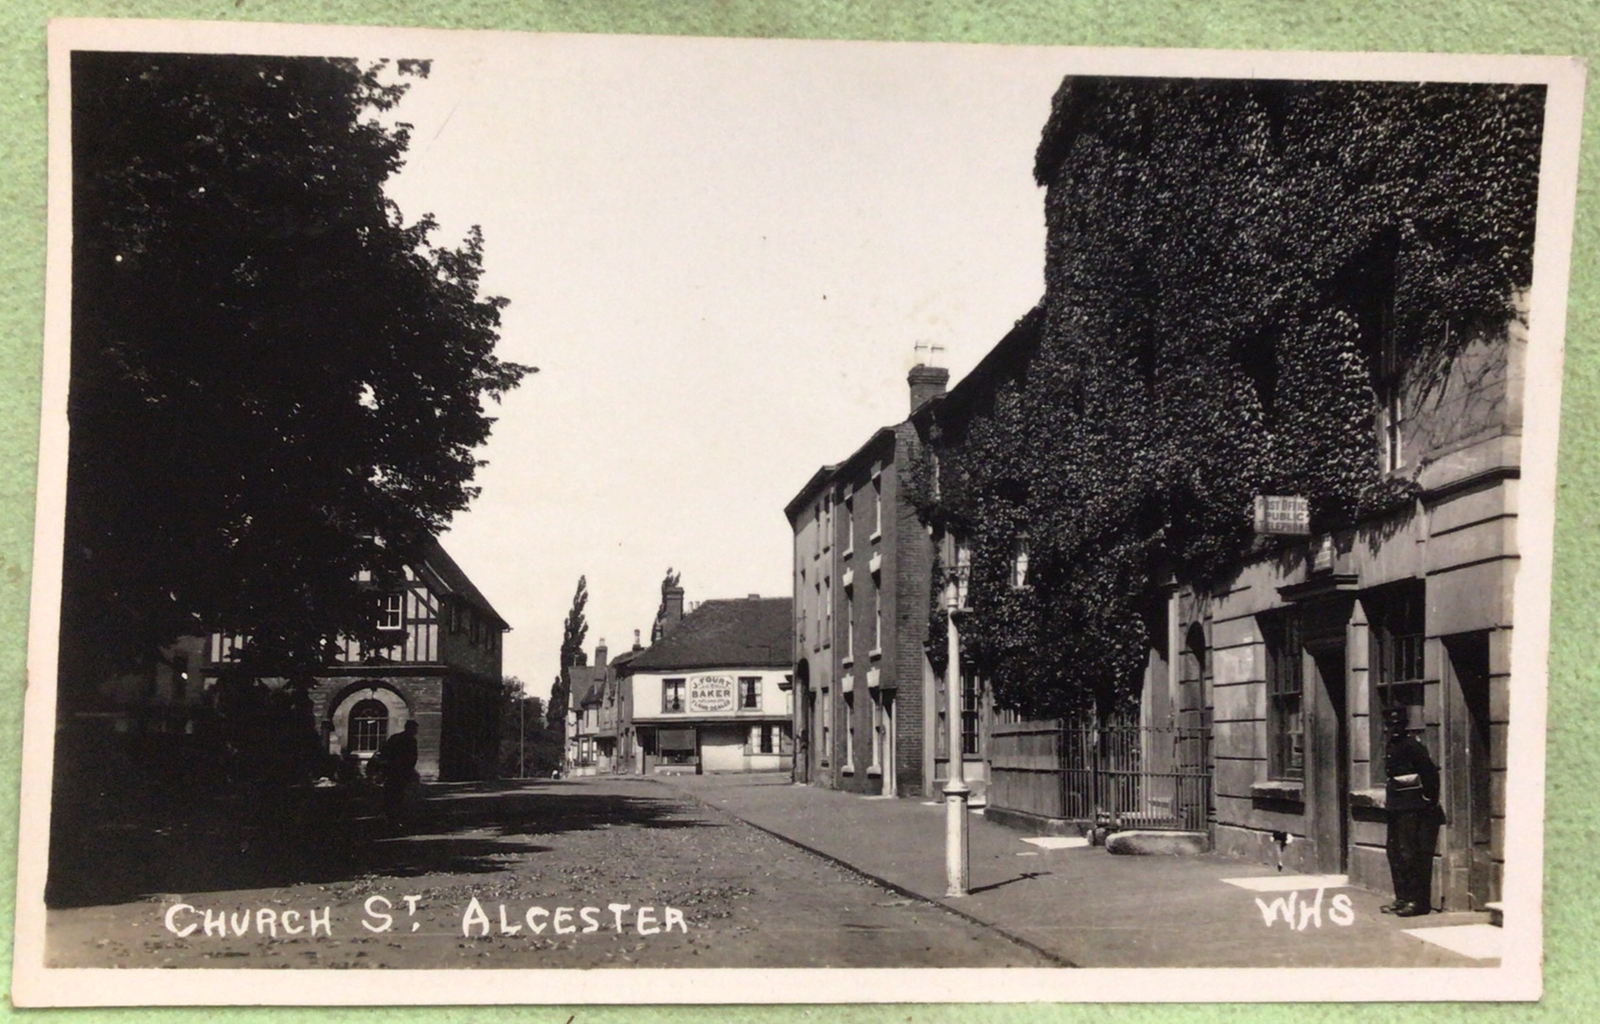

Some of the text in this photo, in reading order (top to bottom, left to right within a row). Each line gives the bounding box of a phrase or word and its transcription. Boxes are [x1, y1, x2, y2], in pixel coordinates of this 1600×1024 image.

[1258, 499, 1307, 511] POST OFFIC
[1264, 512, 1304, 521] PUBLIC
[692, 689, 731, 698] BAKER
